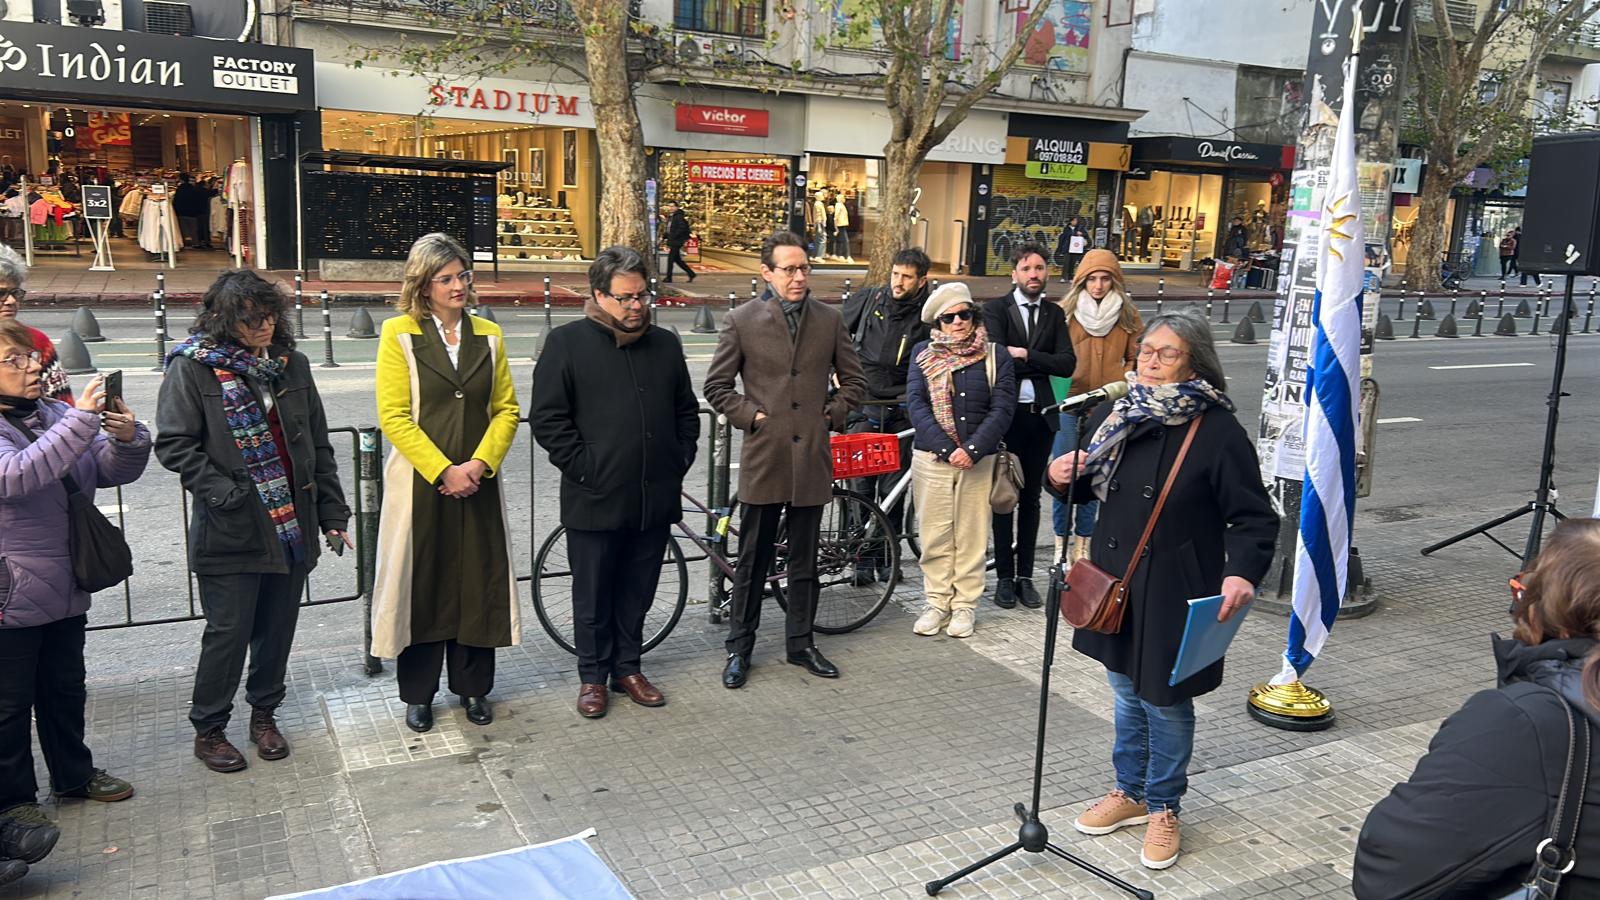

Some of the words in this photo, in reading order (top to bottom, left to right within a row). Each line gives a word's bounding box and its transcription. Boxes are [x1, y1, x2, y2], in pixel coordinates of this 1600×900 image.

[36, 43, 184, 87] Indian
[213, 56, 296, 75] FACTORY
[222, 74, 290, 91] OUTLET
[431, 84, 579, 116] STADIUM
[702, 109, 746, 123] victor
[92, 126, 131, 144] GAS
[1035, 138, 1083, 154] ALQUILA
[1198, 142, 1231, 161] Daniel
[702, 166, 735, 179] PRECIOS
[736, 167, 746, 179] DE
[87, 199, 107, 208] 3x2
